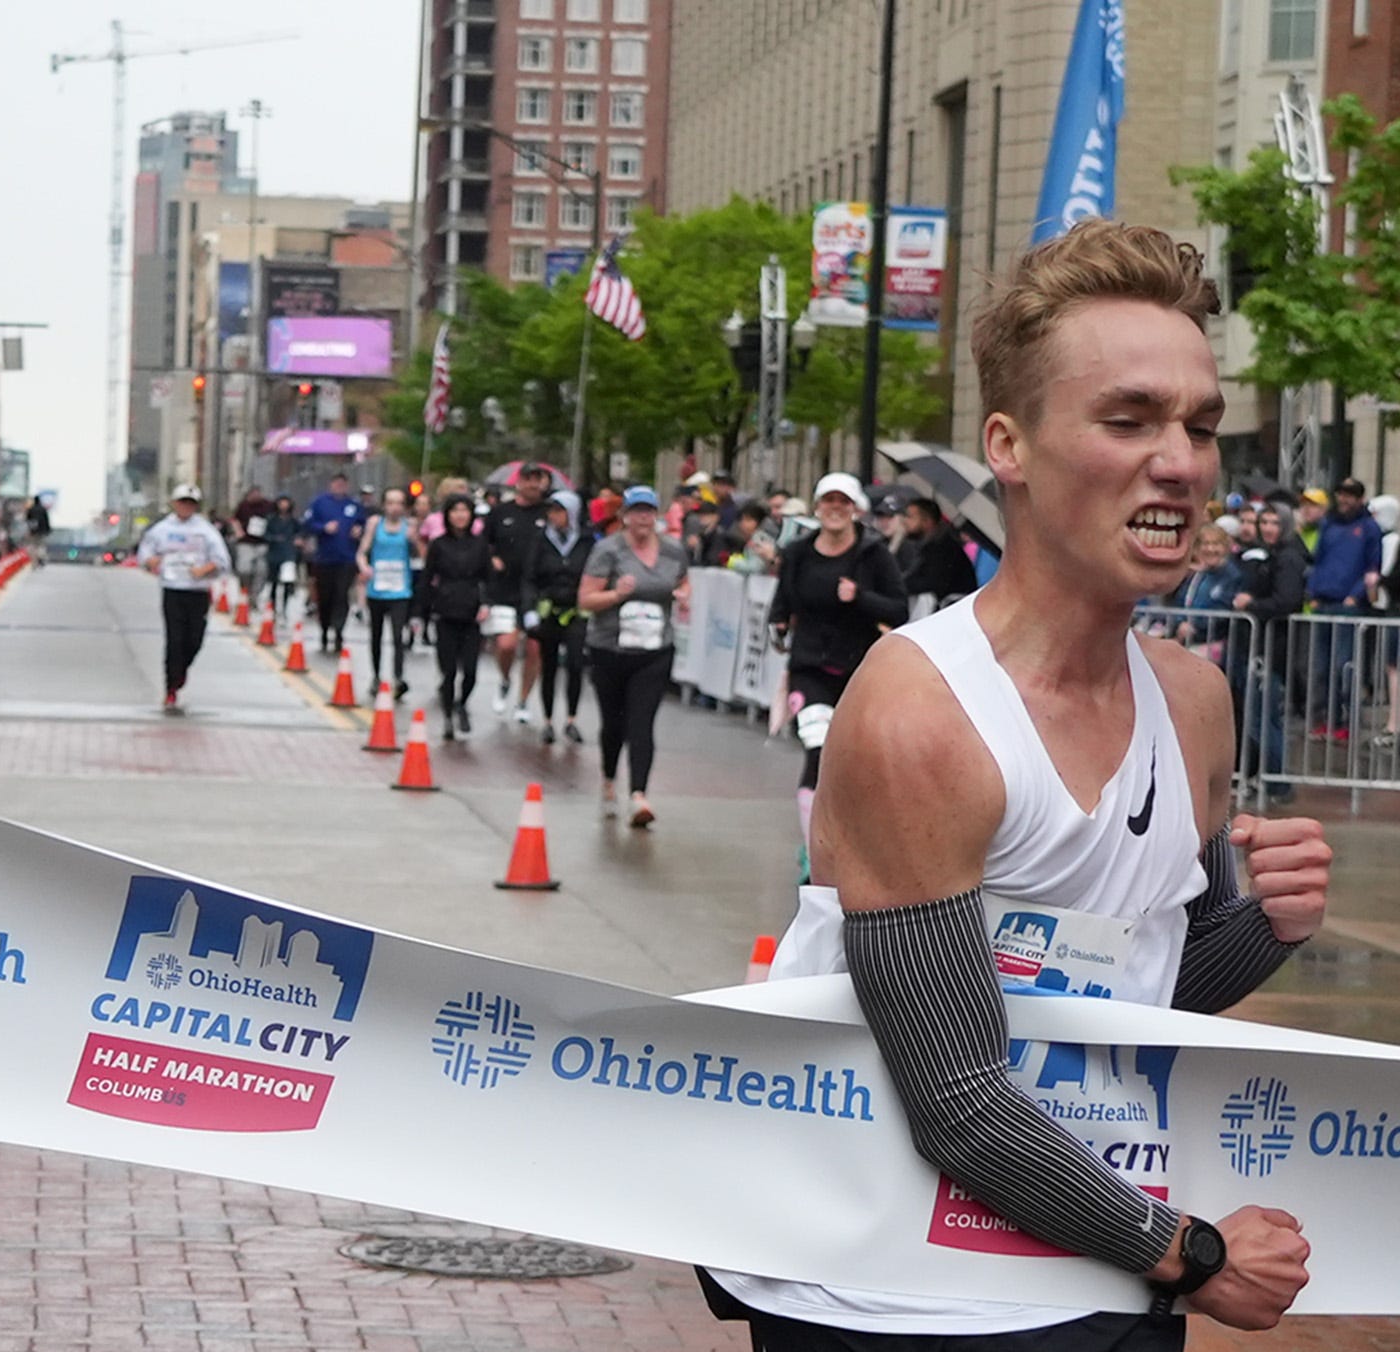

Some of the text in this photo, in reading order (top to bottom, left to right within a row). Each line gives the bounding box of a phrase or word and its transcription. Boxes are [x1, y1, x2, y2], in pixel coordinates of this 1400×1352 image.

[1025, 949, 1046, 960] CITY
[1070, 949, 1115, 965] OhioHealth
[188, 968, 318, 1008] OhioHealth
[91, 992, 350, 1061] CAPITAL CITY
[92, 1047, 315, 1102] HALF MARATHON
[551, 1035, 874, 1121] OhioHealth
[85, 1077, 187, 1107] COLUMBUS
[1102, 1142, 1170, 1172] CITY
[944, 1212, 1019, 1232] COLUMB
